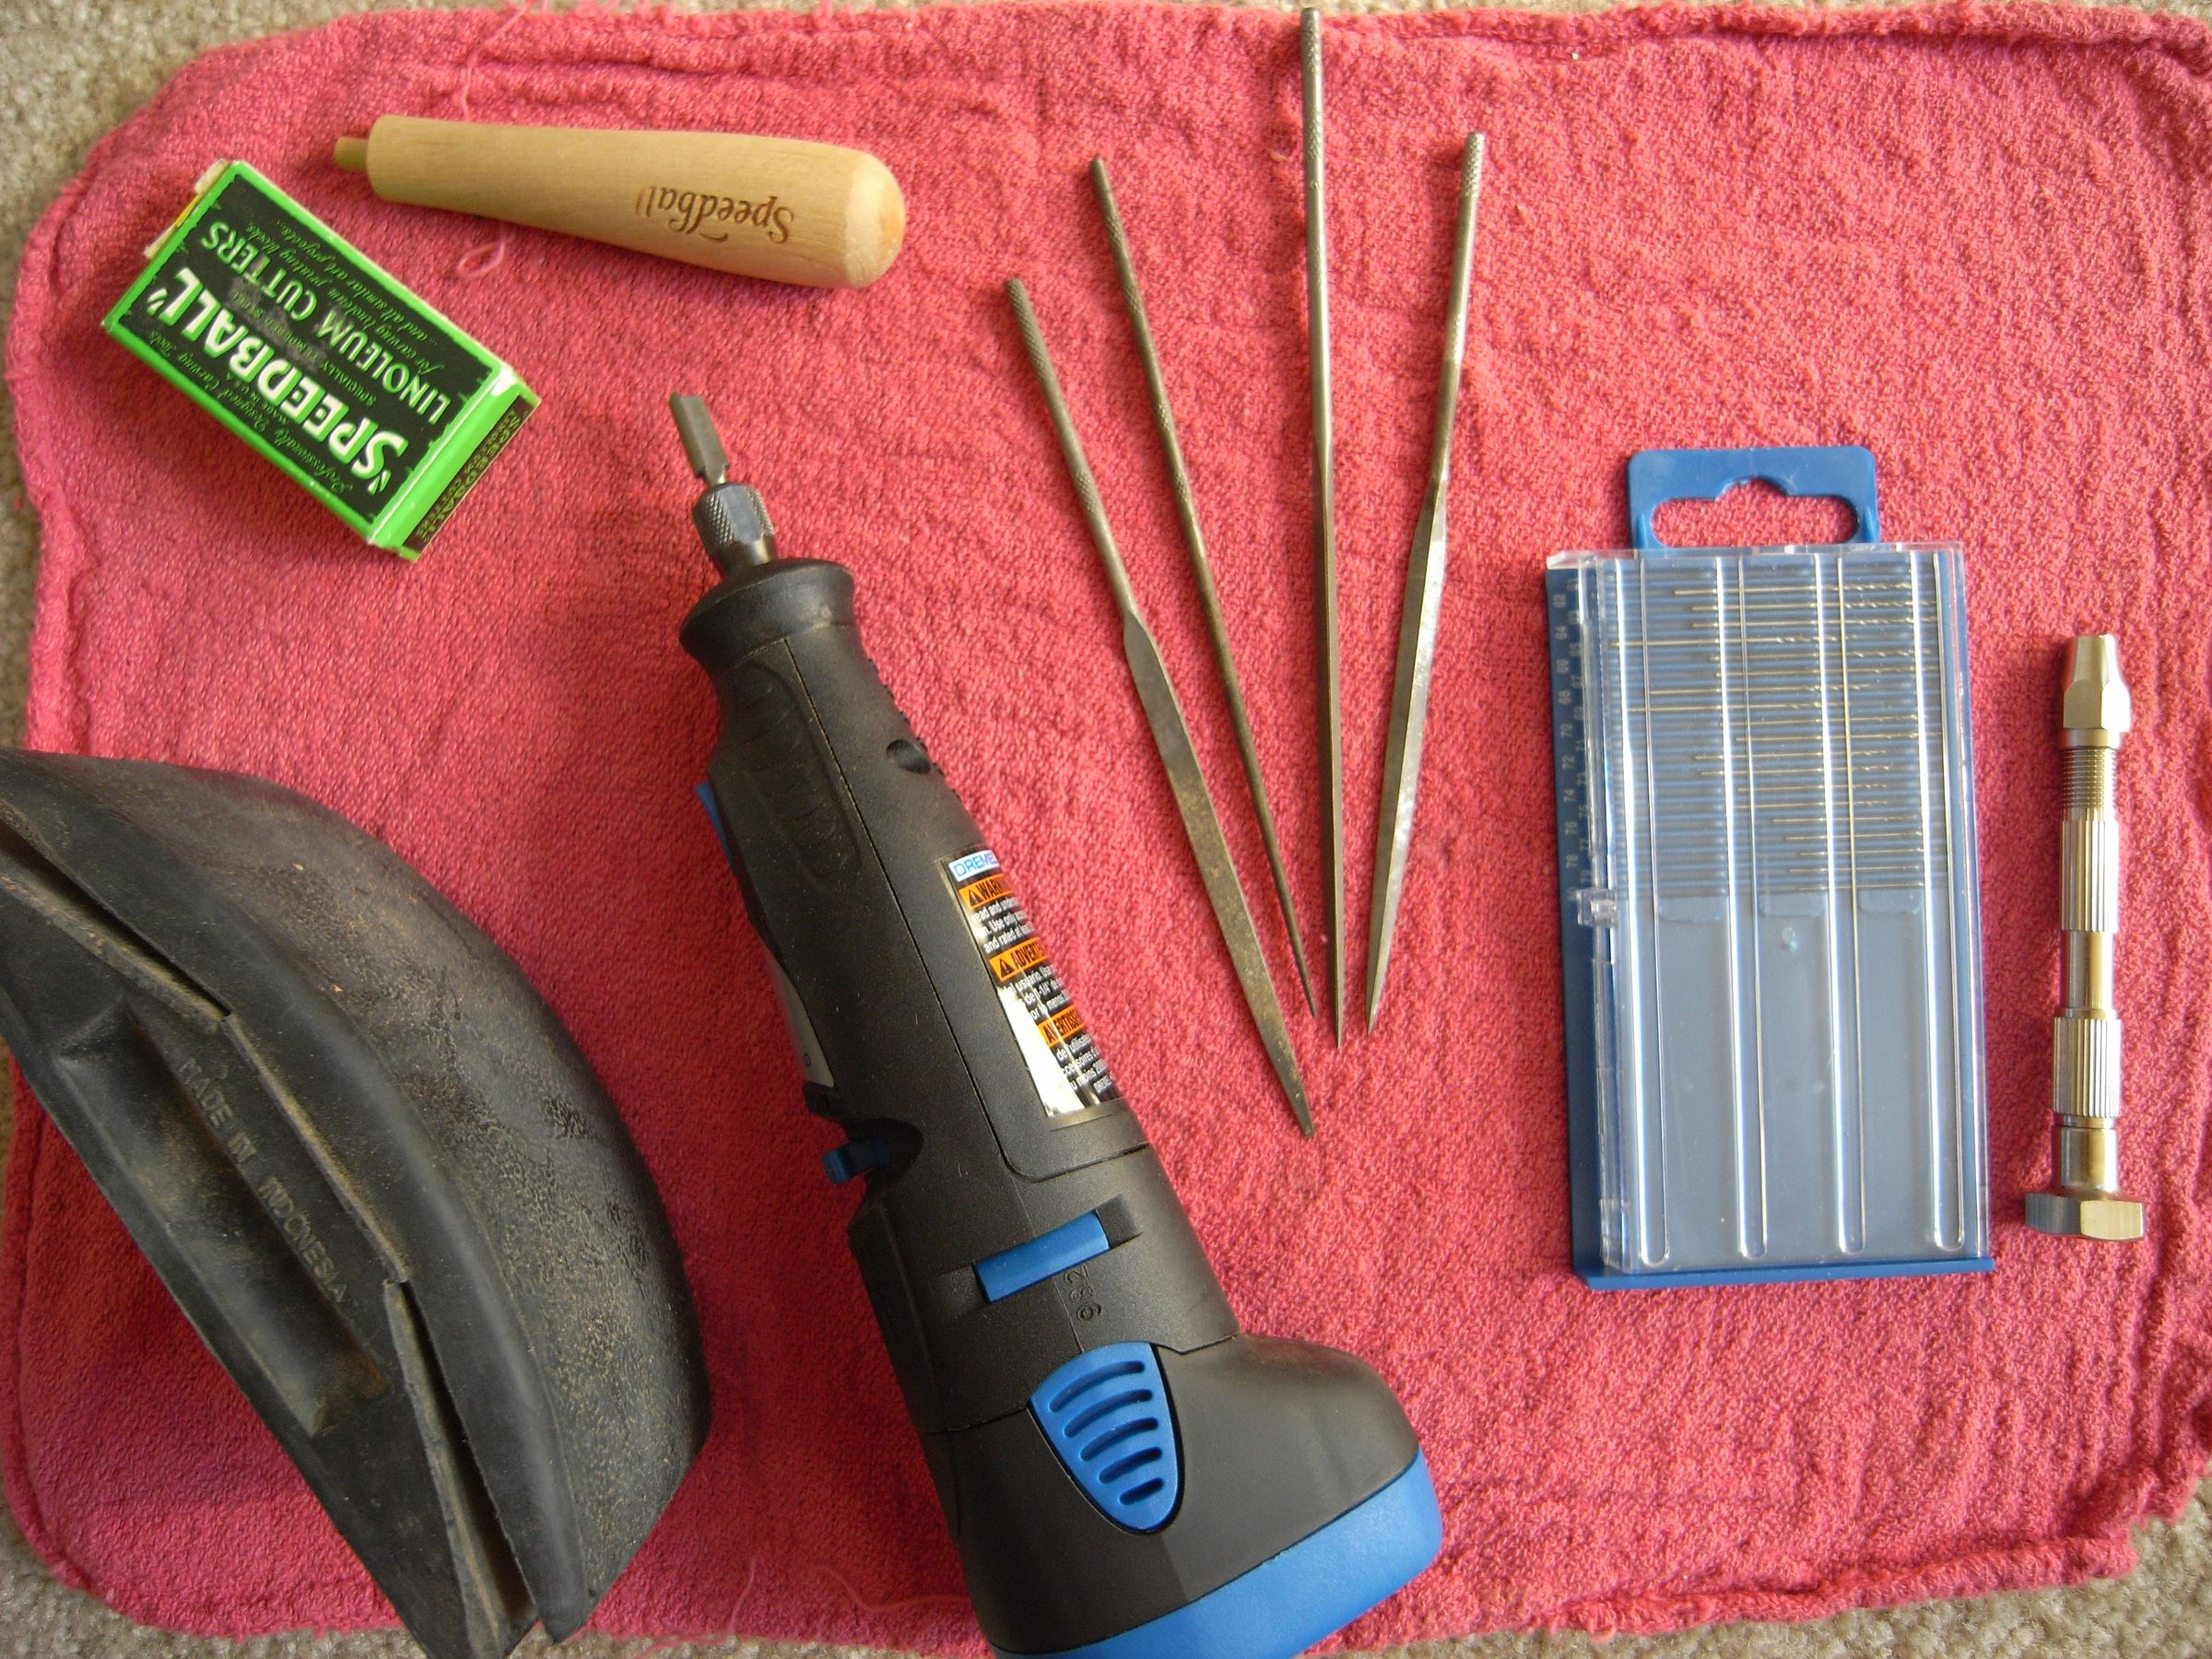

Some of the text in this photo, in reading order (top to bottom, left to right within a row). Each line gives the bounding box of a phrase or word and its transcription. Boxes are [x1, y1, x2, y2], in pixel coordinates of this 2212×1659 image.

[633, 185, 794, 244] Speedball
[196, 217, 453, 426] LINOLEUM CUTTERS
[1559, 724, 1572, 736] 70
[1561, 756, 1574, 770] 72
[1563, 789, 1575, 803] 74
[982, 935, 1000, 954] and
[176, 1059, 348, 1302] MADE IN INDONESIA
